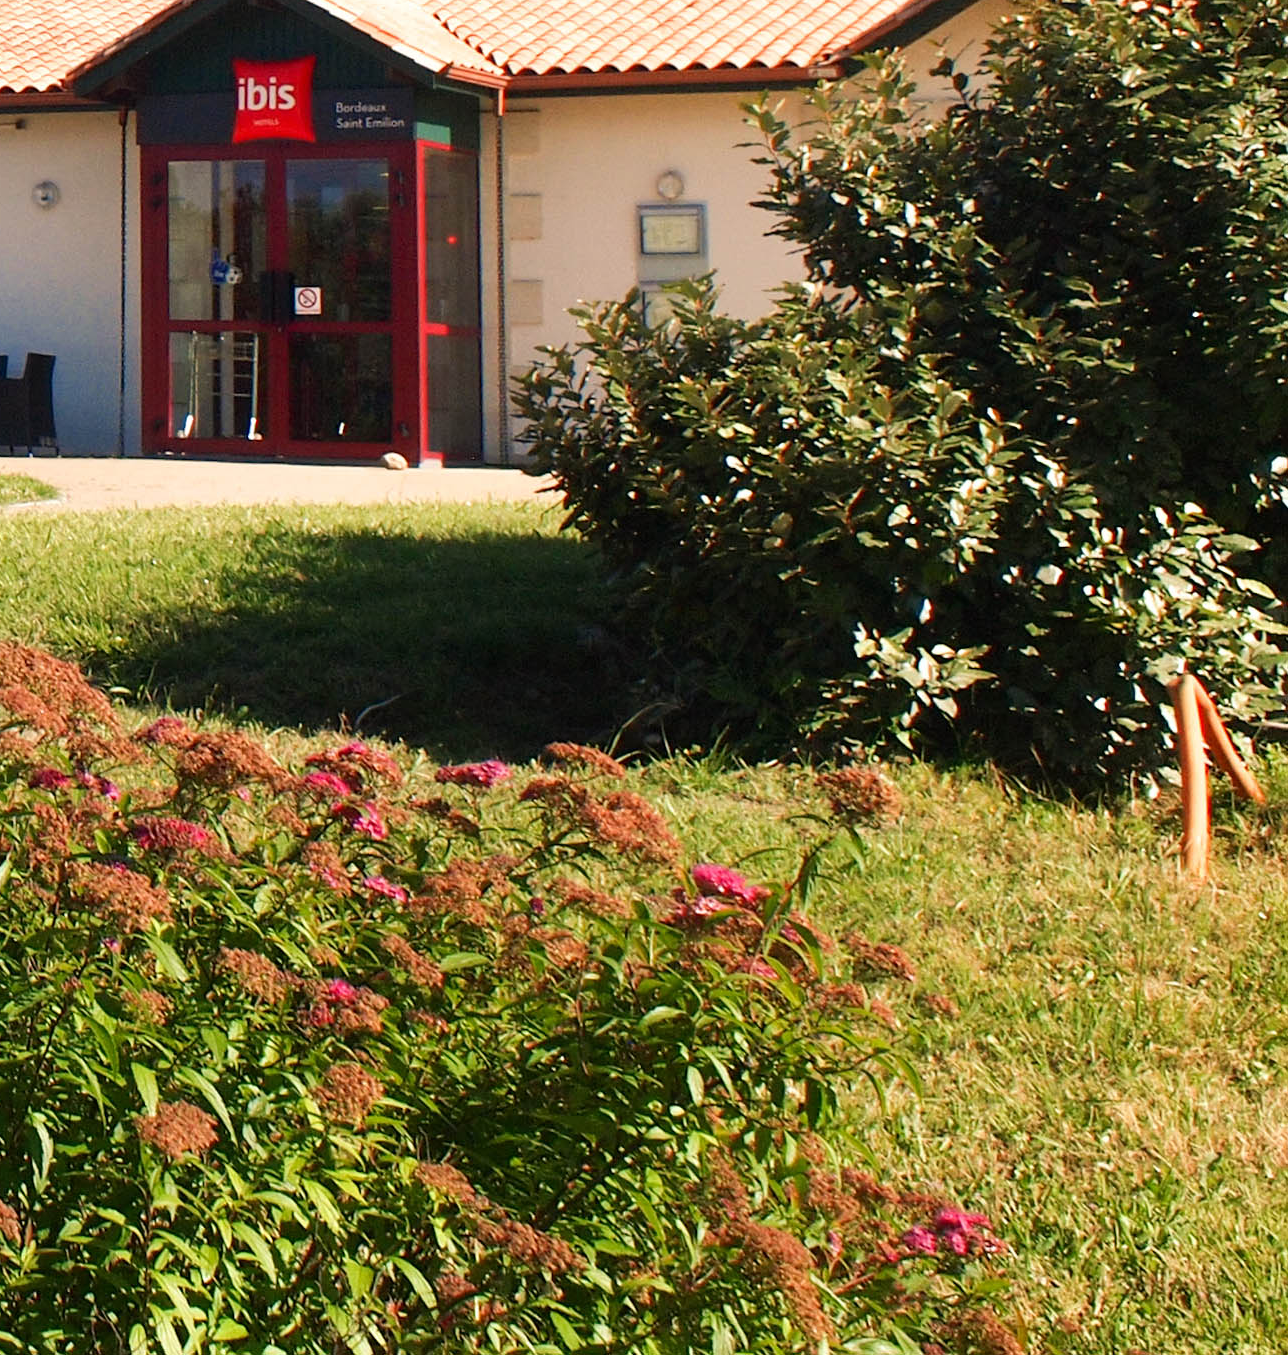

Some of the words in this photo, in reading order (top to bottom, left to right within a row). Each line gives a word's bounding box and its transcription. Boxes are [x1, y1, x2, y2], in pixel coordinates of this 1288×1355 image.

[238, 76, 296, 111] ibis
[336, 101, 386, 113] Bordeaux
[336, 117, 363, 129] Saint
[365, 116, 405, 128] Emilion
